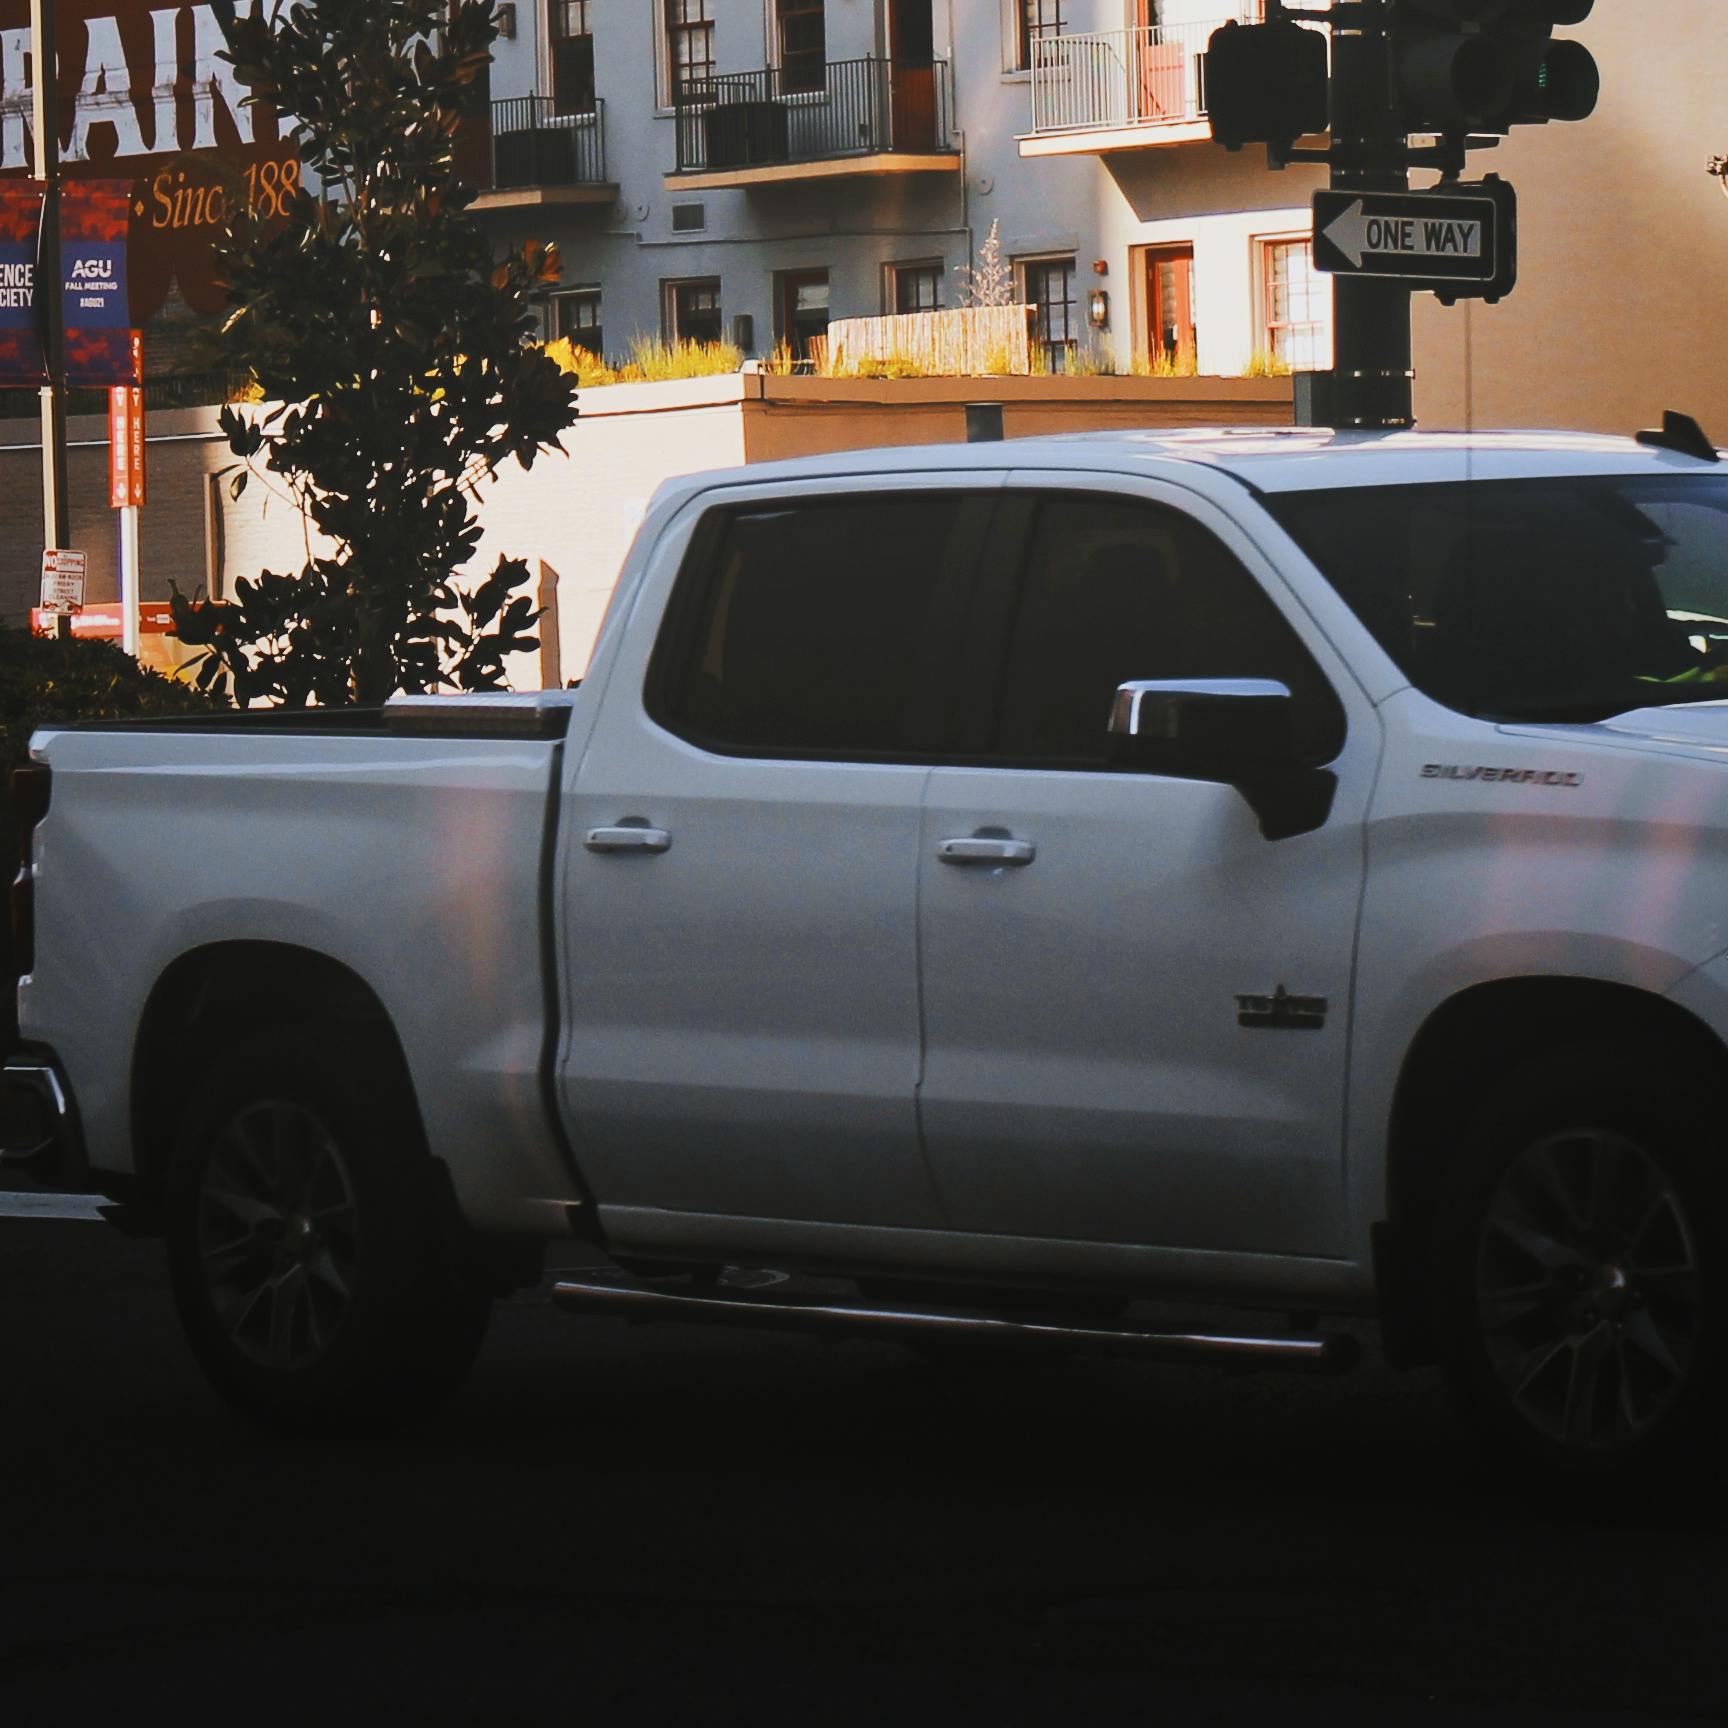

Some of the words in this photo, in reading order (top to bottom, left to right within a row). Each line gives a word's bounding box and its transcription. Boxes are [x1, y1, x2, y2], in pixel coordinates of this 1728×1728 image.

[153, 172, 224, 228] Sinc
[243, 160, 299, 221] 188
[1366, 219, 1415, 250] ONE
[1424, 222, 1475, 253] WAY
[71, 259, 112, 278] AGU
[65, 282, 83, 290] FALL
[84, 282, 118, 291] MEETING
